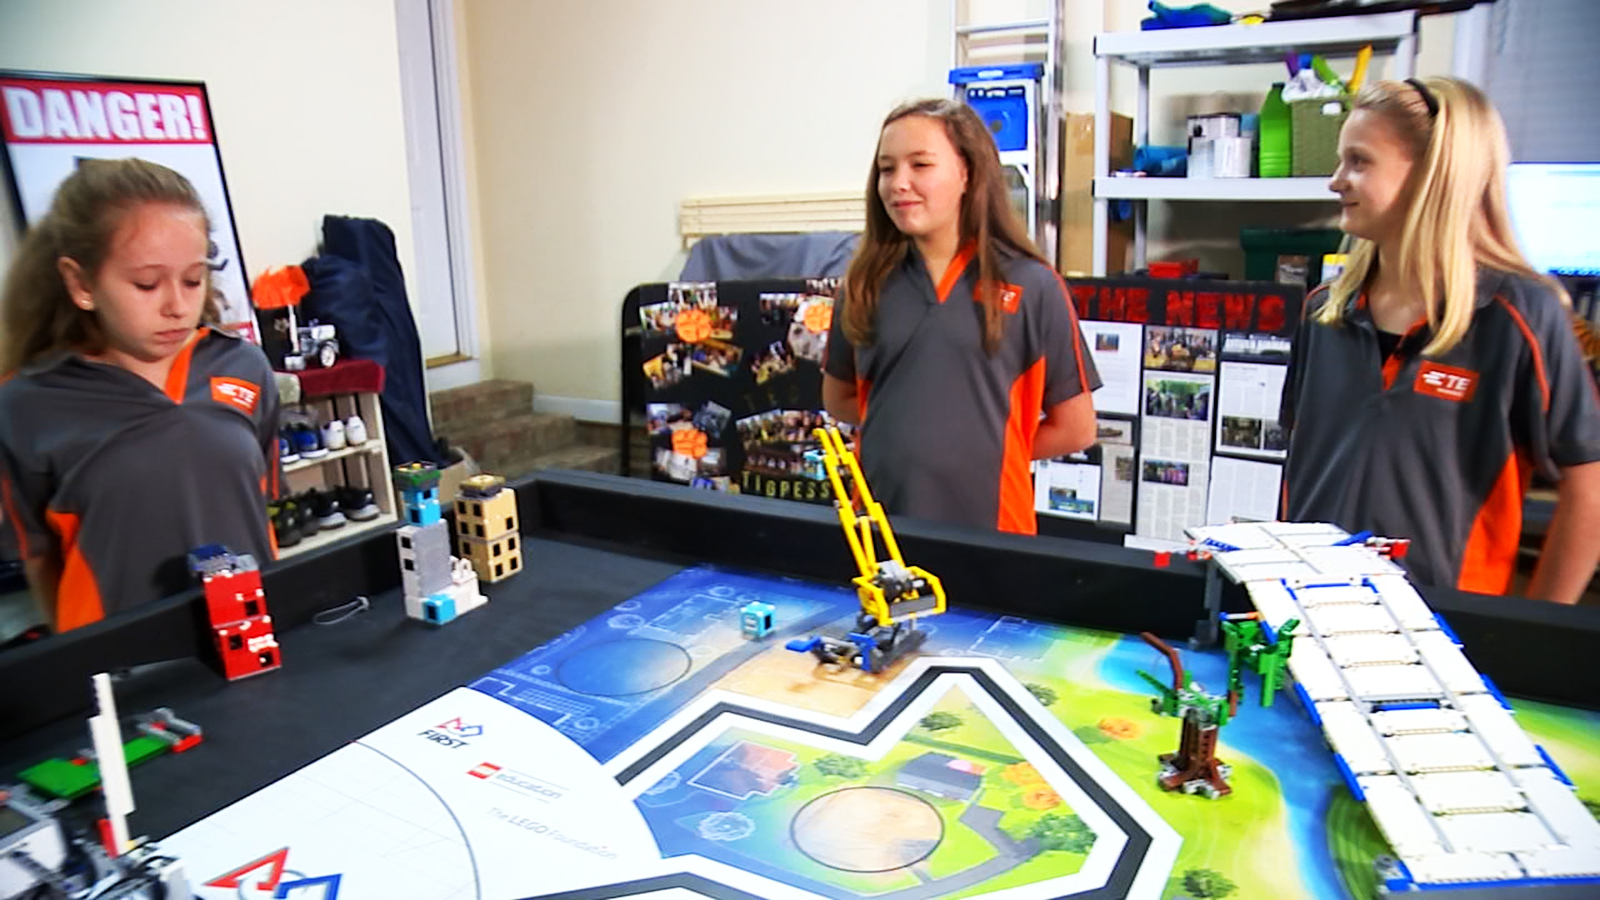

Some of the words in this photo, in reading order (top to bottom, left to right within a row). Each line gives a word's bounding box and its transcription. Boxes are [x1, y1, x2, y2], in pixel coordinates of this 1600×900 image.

[3, 86, 207, 139] DANGER!
[1071, 285, 1149, 322] THE
[1166, 290, 1286, 331] NEWS
[418, 729, 470, 749] FIRST
[495, 773, 562, 799] education
[508, 814, 549, 834] LEGO
